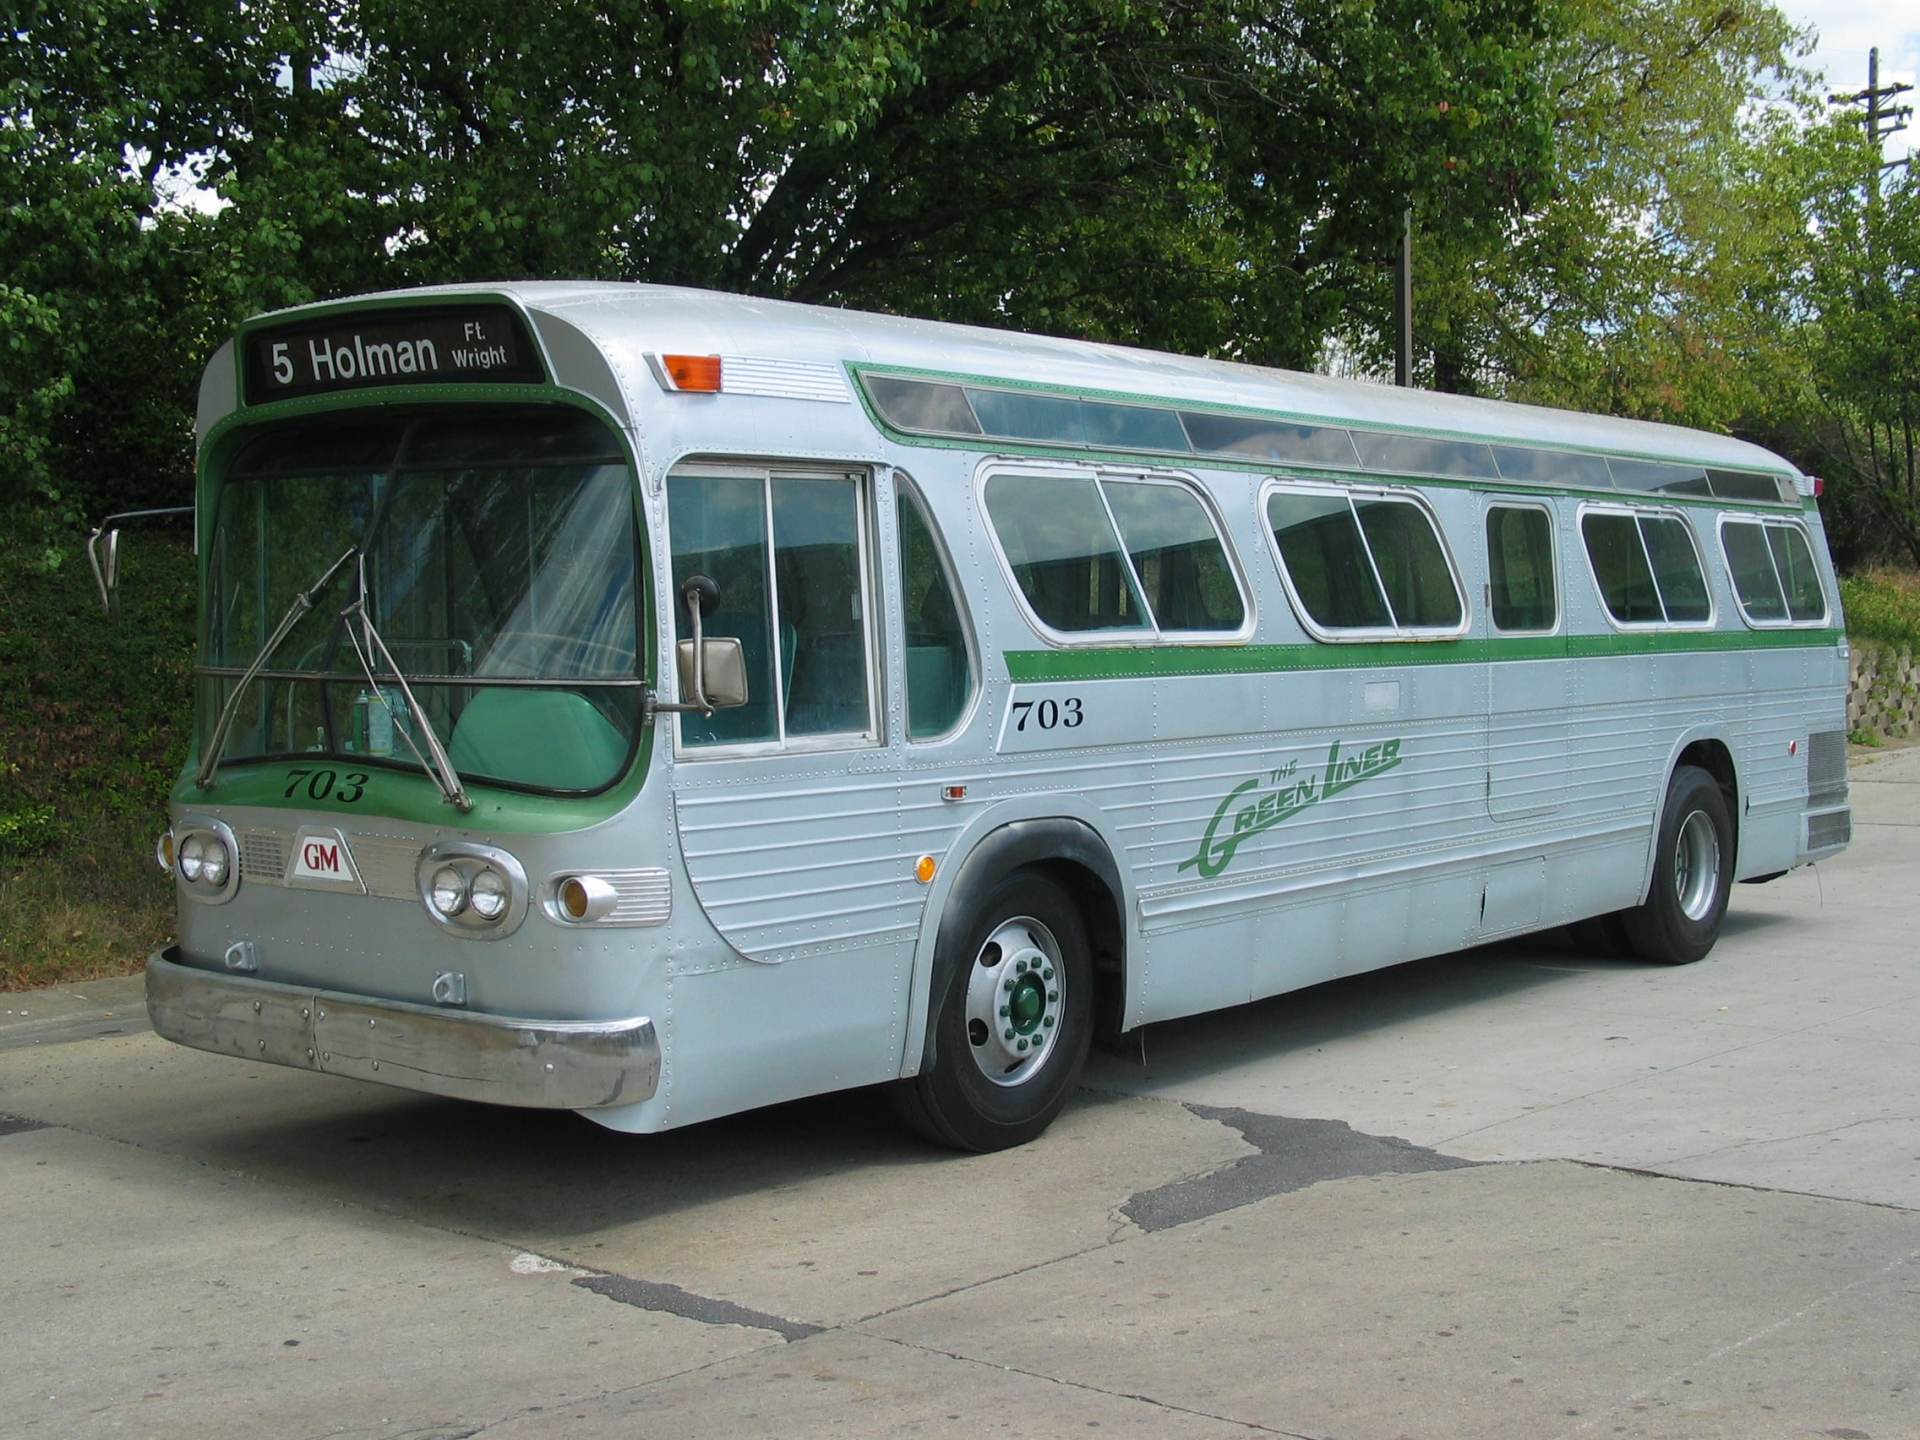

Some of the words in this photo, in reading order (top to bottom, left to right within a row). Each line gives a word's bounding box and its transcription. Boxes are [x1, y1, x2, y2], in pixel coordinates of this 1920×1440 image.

[463, 322, 486, 342] Ft.
[272, 342, 294, 384] 5
[309, 335, 438, 381] Holman
[451, 344, 507, 370] Wright
[1012, 698, 1084, 732] 703
[285, 769, 370, 803] 703
[1269, 758, 1298, 785] THE
[1177, 775, 1319, 878] GREEN
[1321, 737, 1402, 801] LINER
[304, 843, 340, 872] GM
